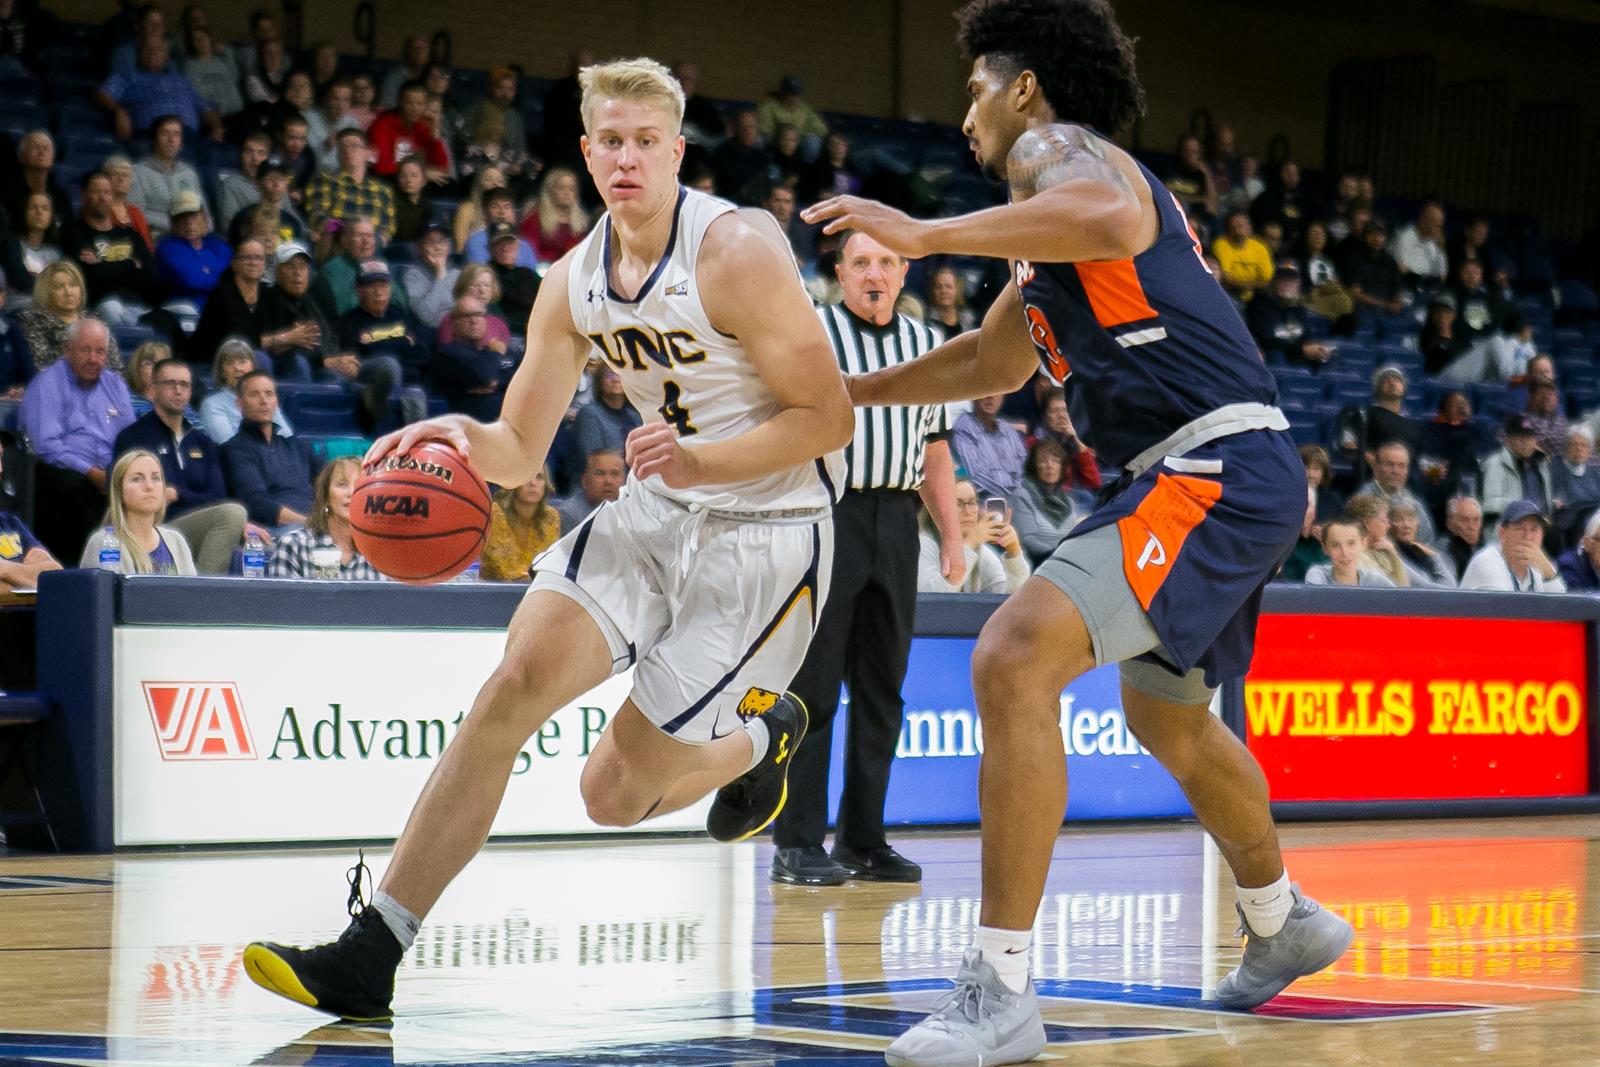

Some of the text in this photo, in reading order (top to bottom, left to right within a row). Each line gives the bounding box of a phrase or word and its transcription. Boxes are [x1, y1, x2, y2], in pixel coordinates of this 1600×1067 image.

[588, 326, 707, 371] UNC
[657, 379, 699, 437] 4
[363, 494, 430, 520] NCAA
[1244, 681, 1581, 737] WELLS FARGO
